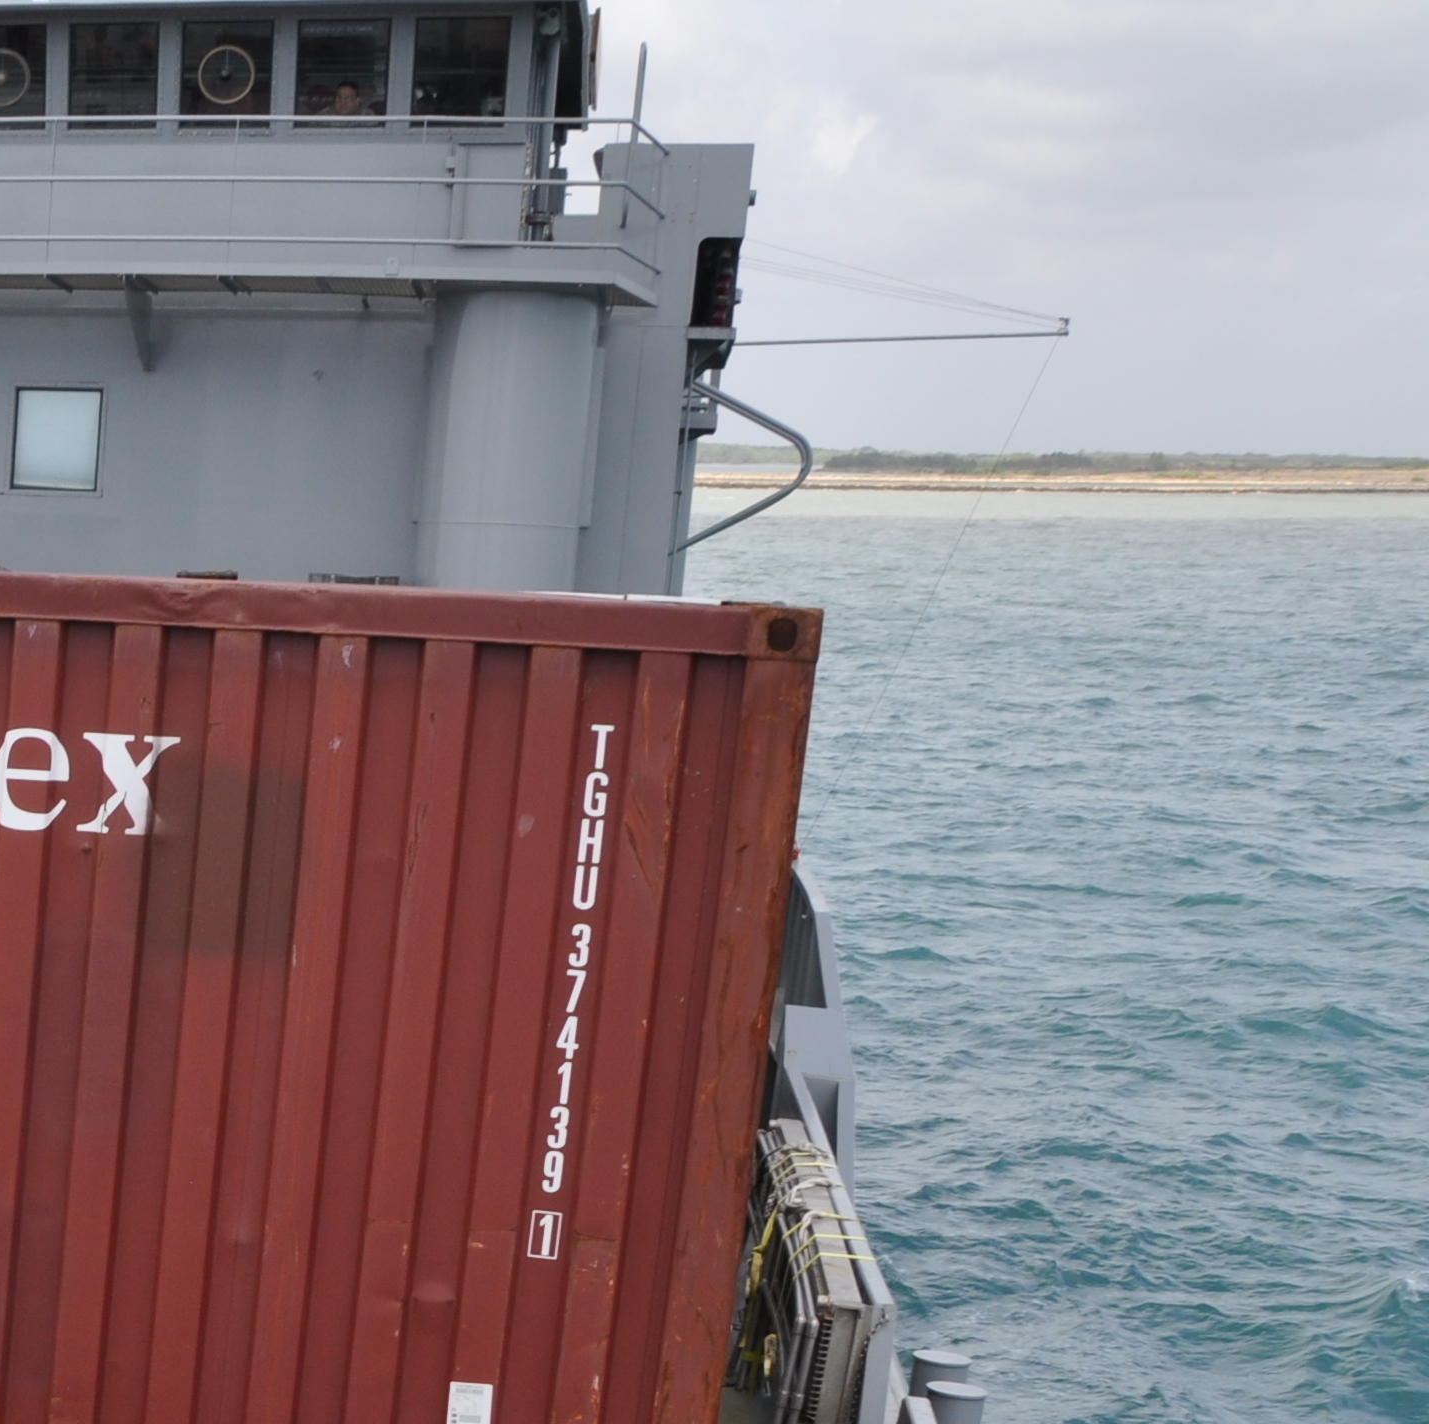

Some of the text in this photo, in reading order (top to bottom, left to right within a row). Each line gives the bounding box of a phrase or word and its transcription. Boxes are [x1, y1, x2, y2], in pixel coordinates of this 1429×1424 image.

[531, 723, 615, 1259] TGHU 374139 1
